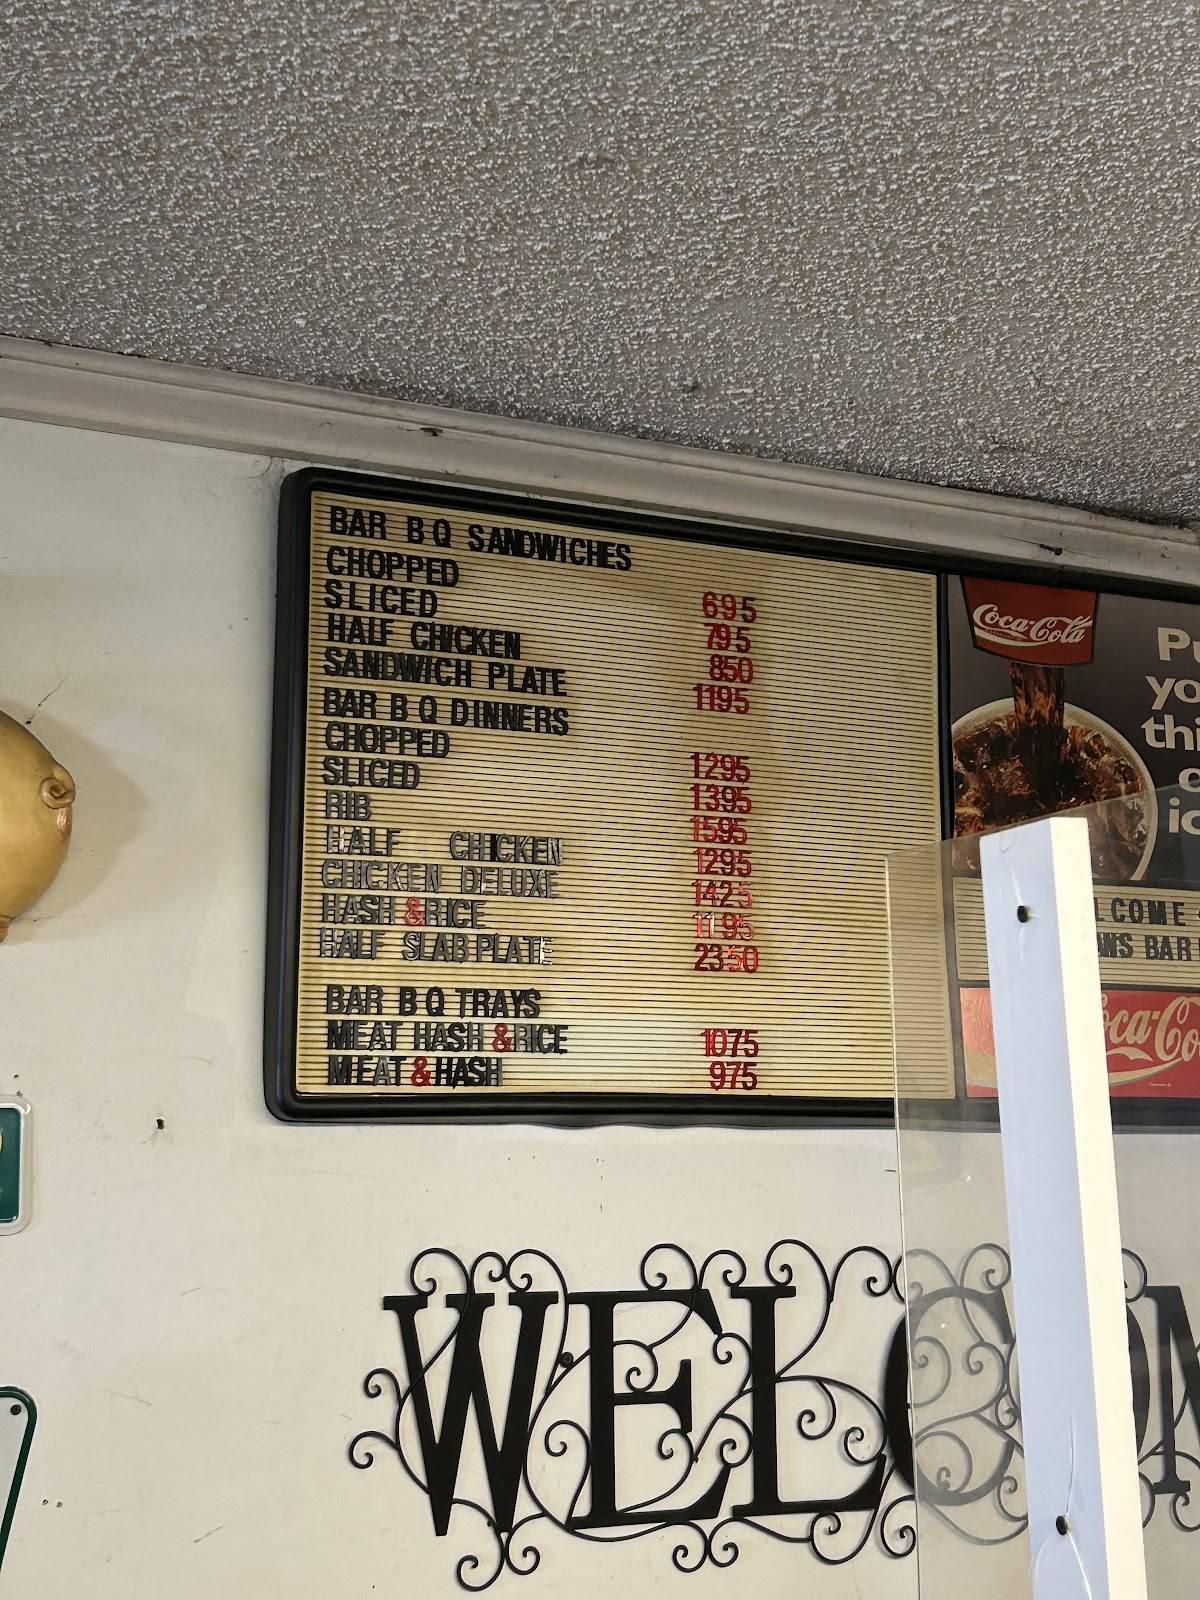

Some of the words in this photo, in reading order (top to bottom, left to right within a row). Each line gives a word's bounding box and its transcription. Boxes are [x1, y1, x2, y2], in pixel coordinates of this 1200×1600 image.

[330, 505, 387, 540] BAR
[407, 516, 425, 545] B
[433, 518, 452, 547] Q
[467, 524, 632, 571] SANDWICHES
[326, 545, 459, 587] CHOPPED
[702, 591, 757, 623] 695
[324, 579, 438, 618] SLICED
[704, 623, 751, 653] 795
[972, 604, 1093, 645] Coca-Cola
[327, 613, 394, 646] HALF
[410, 621, 522, 660] CHICKEN
[709, 653, 753, 684] 850
[1158, 627, 1200, 662] P
[324, 646, 473, 688] SANDWICH
[488, 661, 568, 697] PLATE
[693, 683, 750, 714] 1195
[324, 687, 378, 720] BAR
[391, 692, 409, 722] B
[419, 694, 438, 725] Q
[451, 698, 570, 736] DINNERS
[325, 720, 451, 758] CHOPPED
[691, 751, 752, 783] 1295
[322, 755, 421, 790] SLICED
[690, 783, 752, 814] 1395
[326, 789, 372, 821] RIB
[690, 815, 748, 845] 1595
[326, 825, 400, 857] HALF
[450, 831, 563, 866] CHICKEN
[693, 848, 752, 878] 1295
[321, 858, 443, 893] CHICKEN
[461, 865, 560, 898] DELUXE
[692, 879, 753, 909] 1425
[322, 893, 397, 925] HASH
[692, 911, 755, 941] 1195
[320, 926, 385, 960] HALF
[694, 943, 759, 973] 2350
[326, 984, 384, 1016] BAR
[400, 986, 418, 1017] B
[425, 986, 445, 1017] Q
[455, 987, 541, 1019] TRAYS
[326, 1020, 403, 1051] MEAT
[413, 1021, 484, 1052] HASH
[700, 1028, 759, 1058] 1075
[709, 1061, 758, 1091] 975
